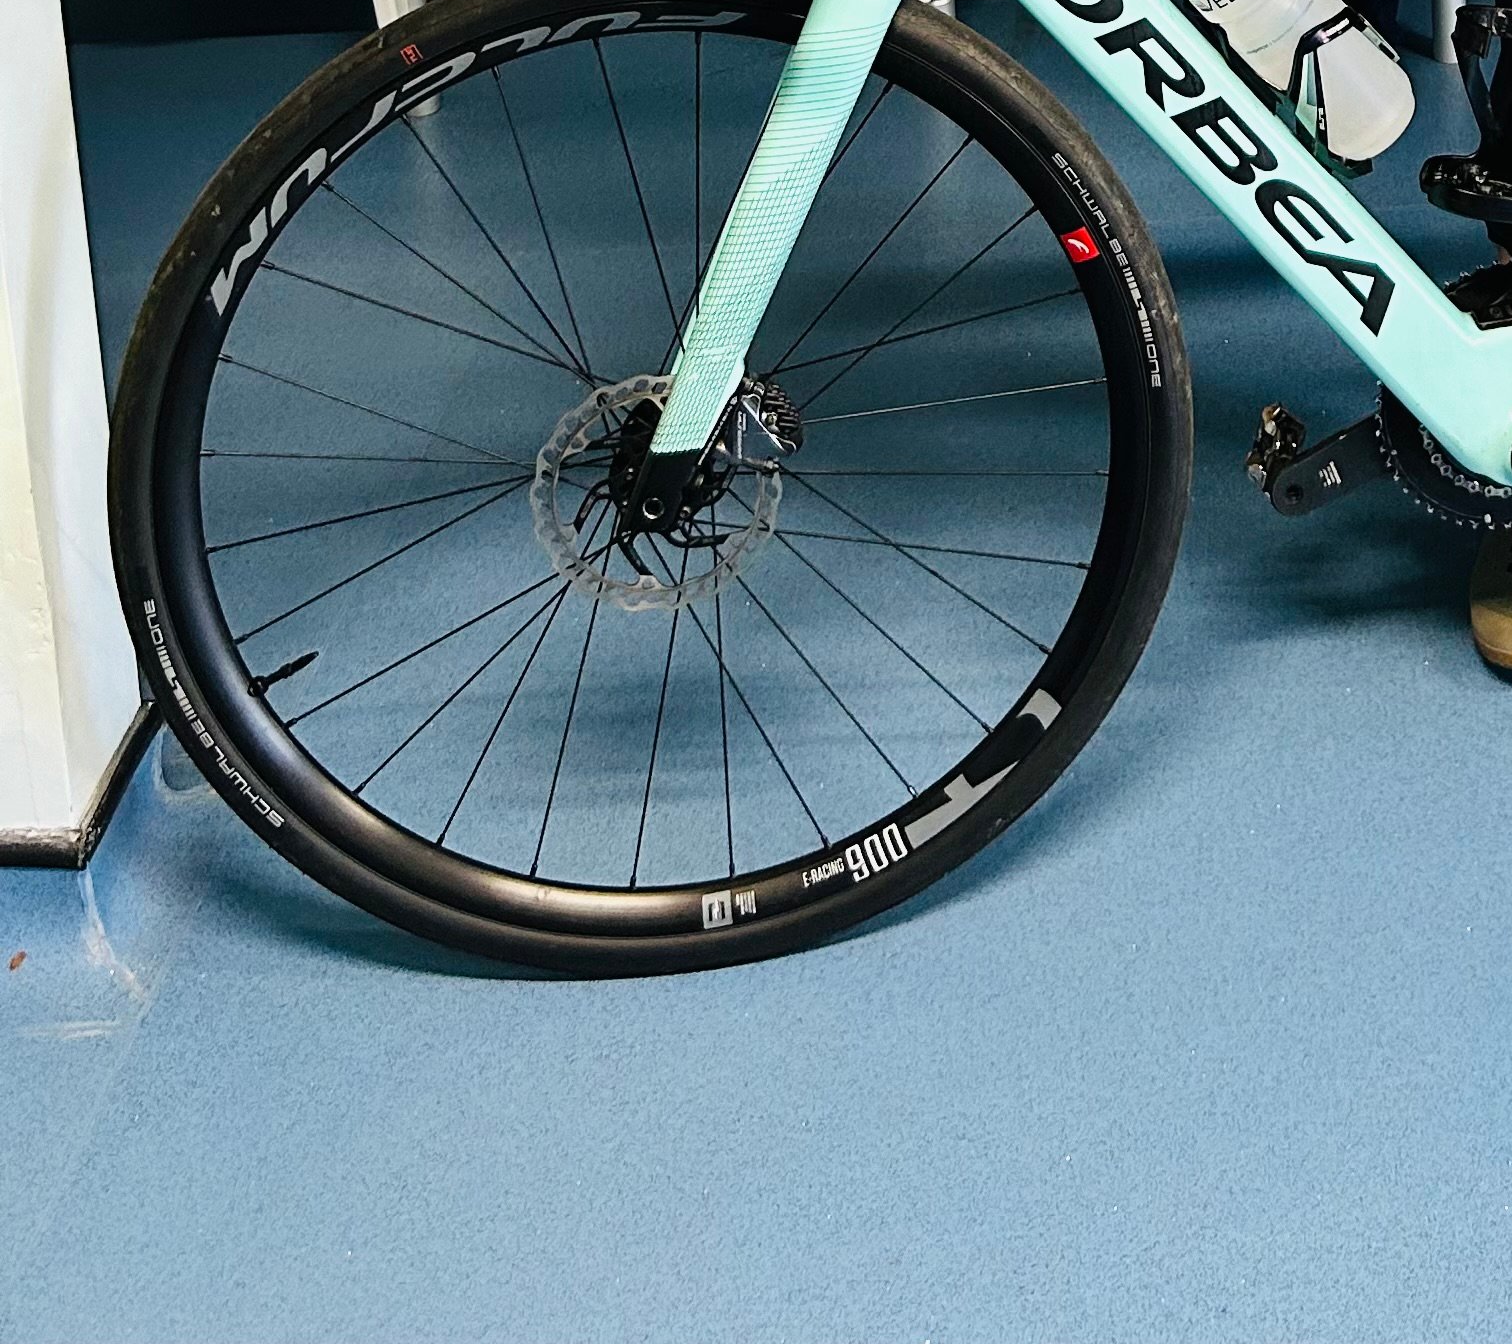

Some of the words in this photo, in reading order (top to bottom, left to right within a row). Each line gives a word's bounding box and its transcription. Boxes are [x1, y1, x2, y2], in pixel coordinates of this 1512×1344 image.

[1051, 152, 1129, 267] SCHWALBE
[1146, 344, 1162, 388] ONE
[190, 718, 285, 828] SCHWALBE
[802, 857, 845, 888] E-RACING
[845, 822, 909, 883] 900
